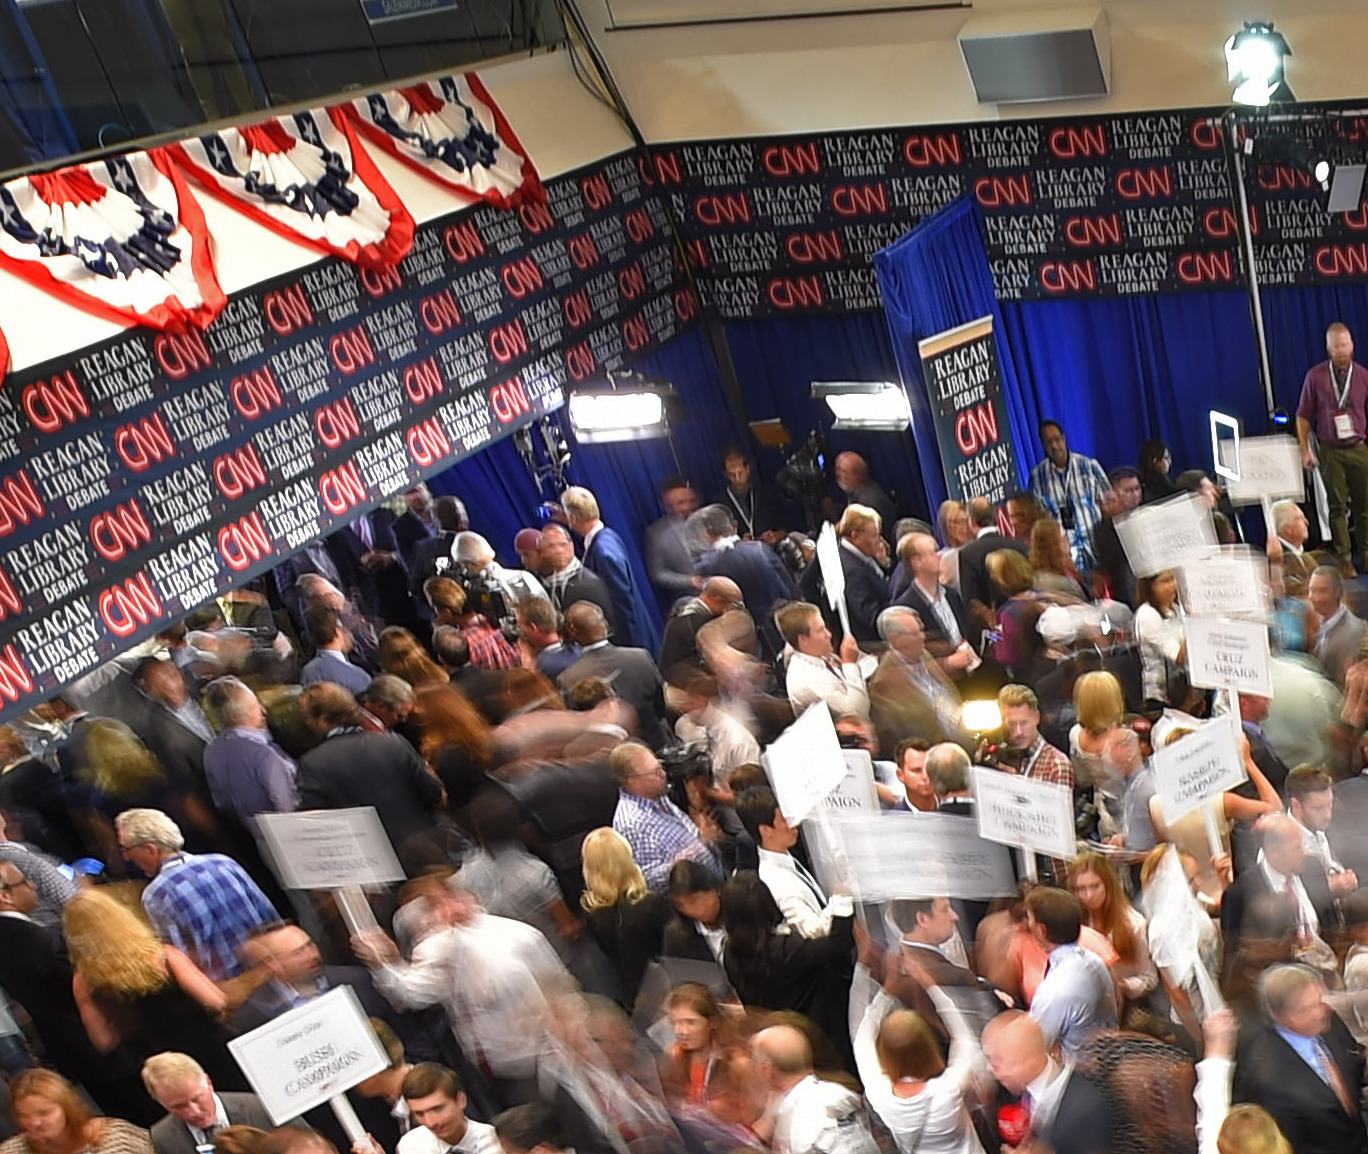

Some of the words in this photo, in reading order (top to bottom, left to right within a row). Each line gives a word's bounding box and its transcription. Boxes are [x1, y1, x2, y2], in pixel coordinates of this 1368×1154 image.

[969, 125, 1039, 144] REAGAN
[1049, 125, 1106, 157] CNN
[1112, 115, 1182, 135] REAGAN
[1114, 132, 1183, 149] LIBRARY
[683, 143, 756, 161] REAGAN
[764, 142, 820, 175] CNN
[823, 133, 894, 152] REAGAN
[827, 149, 895, 167] LIBRARY
[904, 133, 962, 166] CNN
[972, 140, 1041, 158] LIBRARY
[686, 159, 755, 177] LIBRARY
[892, 174, 961, 193] REAGAN
[1036, 166, 1106, 186] REAGAN
[1116, 165, 1172, 199] CNN
[582, 174, 611, 210] CNN
[753, 183, 822, 201] REAGAN
[831, 182, 888, 215] CNN
[974, 174, 1031, 206] CNN
[1038, 182, 1106, 199] LIBRARY
[694, 192, 751, 224] CNN
[756, 200, 823, 217] LIBRARY
[986, 214, 1055, 232] REAGAN
[1126, 205, 1196, 224] REAGAN
[1267, 212, 1333, 229] LIBRARY
[482, 217, 522, 244] LIBRARY
[625, 206, 654, 244] CNN
[709, 231, 778, 249] REAGAN
[989, 229, 1056, 245] LIBRARY
[1065, 214, 1122, 245] CNN
[1129, 221, 1196, 238] LIBRARY
[444, 220, 484, 264] CNN
[570, 231, 600, 270] CNN
[712, 247, 778, 263] LIBRARY
[787, 229, 842, 262] CNN
[402, 245, 447, 276] LIBRARY
[502, 255, 543, 299] CNN
[1039, 260, 1096, 292] CNN
[1100, 251, 1169, 270] REAGAN
[1103, 267, 1169, 284] LIBRARY
[1177, 250, 1233, 284] CNN
[302, 262, 355, 293] REAGAN
[452, 266, 497, 298] REAGAN
[619, 262, 646, 299] CNN
[768, 275, 823, 307] CNN
[264, 283, 314, 336] CNN
[312, 280, 360, 312] LIBRARY
[328, 300, 359, 322] DEBATE
[419, 289, 461, 334] CNN
[460, 286, 502, 314] LIBRARY
[564, 290, 592, 328] CNN
[365, 301, 414, 333] REAGAN
[473, 304, 502, 324] DEBATE
[209, 322, 265, 354] LIBRARY
[373, 319, 419, 351] LIBRARY
[439, 332, 485, 362] REAGAN
[489, 318, 529, 364] CNN
[622, 312, 650, 351] CNN
[80, 337, 146, 381] REAGAN
[229, 339, 264, 364] DEBATE
[271, 336, 325, 375] REAGAN
[329, 324, 375, 375] CNN
[389, 340, 418, 361] DEBATE
[445, 350, 490, 381] LIBRARY
[567, 341, 595, 381] CNN
[935, 340, 989, 379] REAGAN
[92, 362, 155, 401] LIBRARY
[280, 356, 331, 393] LIBRARY
[403, 356, 444, 405] CNN
[458, 370, 488, 389] DEBATE
[522, 350, 563, 386] REAGAN
[526, 368, 567, 400] LIBRARY
[940, 362, 990, 400] LIBRARY
[22, 370, 90, 432] CNN
[112, 386, 154, 413] DEBATE
[162, 381, 225, 422] REAGAN
[230, 364, 283, 420] CNN
[298, 379, 330, 403] DEBATE
[351, 369, 399, 405] REAGAN
[490, 375, 529, 423] CNN
[954, 386, 986, 411] DEBATE
[359, 388, 404, 422] LIBRARY
[373, 409, 402, 432] DEBATE
[439, 390, 486, 421] REAGAN
[172, 403, 231, 442] LIBRARY
[255, 413, 309, 451] REAGAN
[315, 395, 361, 449] CNN
[446, 407, 492, 442] LIBRARY
[955, 400, 1000, 455] CNN
[115, 412, 176, 472] CNN
[192, 426, 230, 452] DEBATE
[264, 431, 315, 470] LIBRARY
[356, 432, 401, 466] REAGAN
[407, 416, 450, 467] CNN
[462, 429, 492, 451] DEBATE
[31, 432, 104, 480] REAGAN
[213, 443, 266, 499] CNN
[282, 455, 314, 480] DEBATE
[362, 451, 407, 488] LIBRARY
[959, 443, 1008, 485] REAGAN
[41, 453, 112, 501] LIBRARY
[142, 461, 207, 502] REAGAN
[319, 460, 367, 516] CNN
[378, 474, 410, 497] DEBATE
[66, 484, 110, 512] DEBATE
[152, 484, 212, 526] LIBRARY
[259, 478, 315, 520] REAGAN
[90, 498, 152, 562] CNN
[173, 504, 212, 536] DEBATE
[269, 498, 322, 540] LIBRARY
[286, 522, 321, 548] DEBATE
[7, 520, 82, 574] REAGAN
[149, 532, 212, 582] REAGAN
[218, 511, 273, 571] CNN
[19, 541, 90, 595] LIBRARY
[159, 555, 220, 601] LIBRARY
[44, 574, 88, 604] DEBATE
[99, 570, 163, 637] CNN
[179, 580, 217, 610] DEBATE
[17, 597, 92, 652] REAGAN
[30, 620, 100, 675] LIBRARY
[53, 651, 99, 684] DEBATE
[1205, 663, 1259, 680] CAMPAIGN
